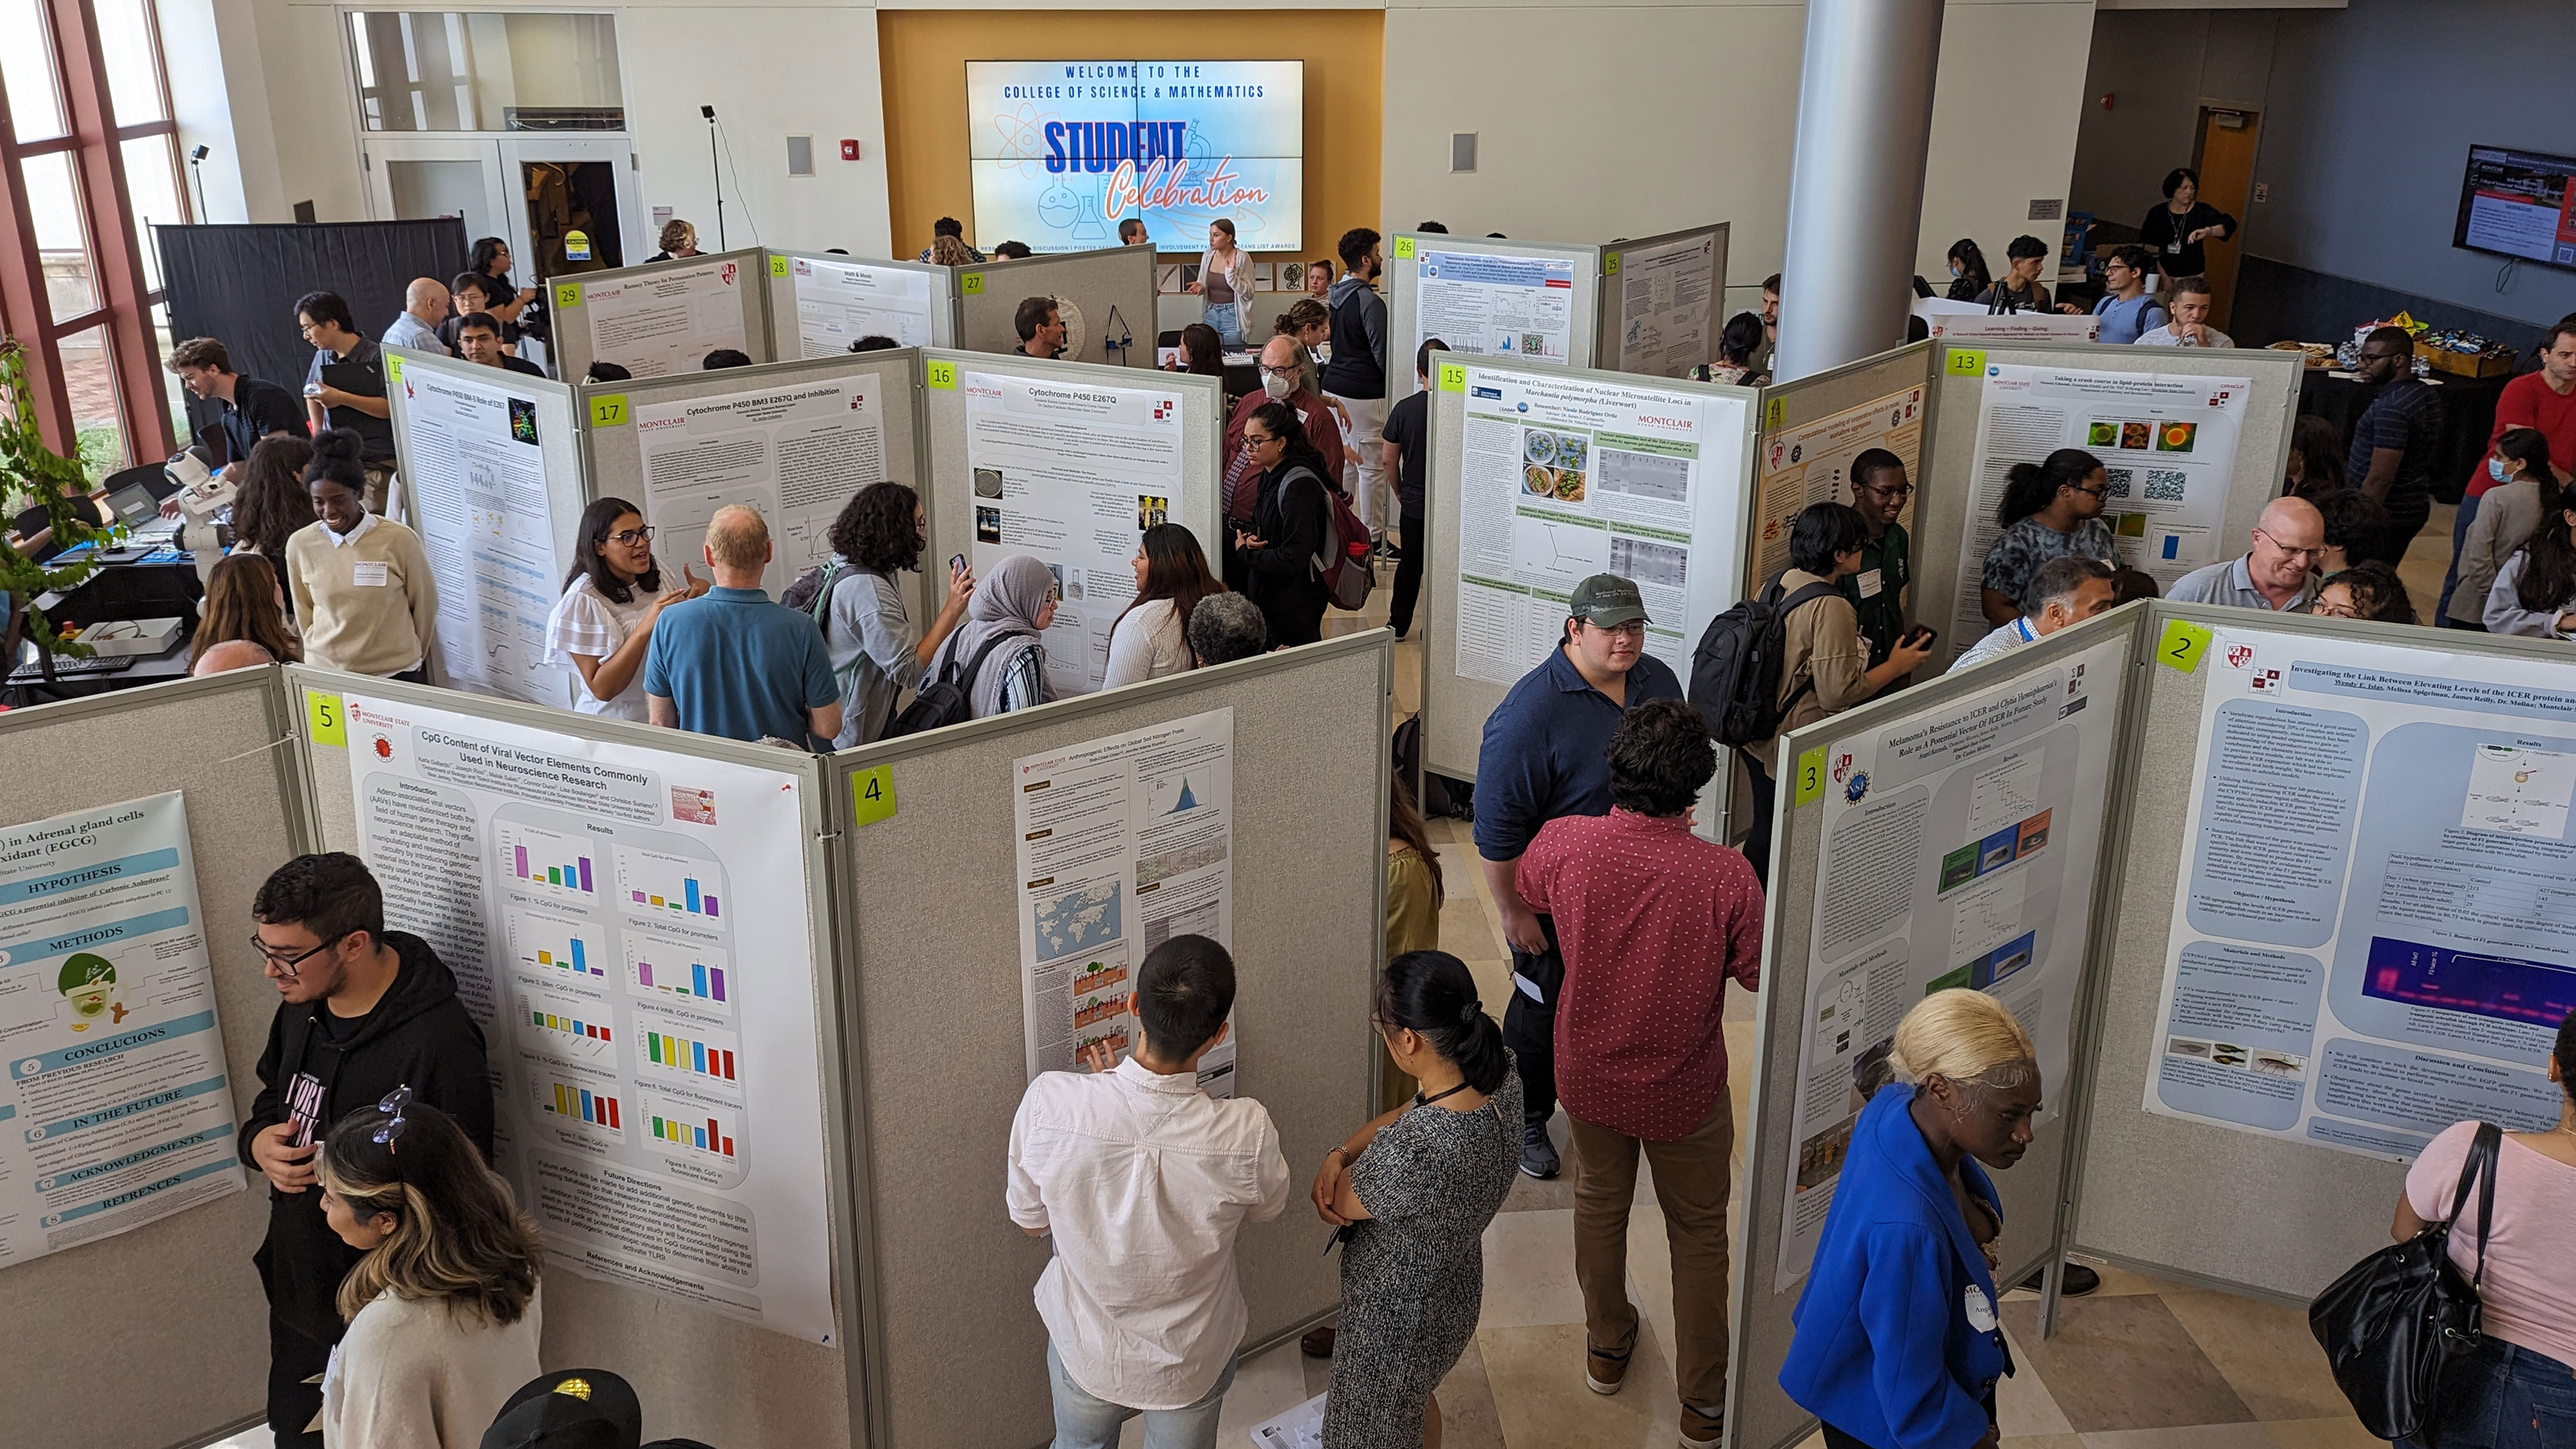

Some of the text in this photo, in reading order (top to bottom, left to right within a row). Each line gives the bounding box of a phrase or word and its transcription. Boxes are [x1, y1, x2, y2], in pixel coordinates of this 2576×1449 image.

[1065, 65, 1199, 79] WELCOME TO THE
[1004, 85, 1263, 99] COLLEGE OF SCIENCE & MATHEMATICS
[1045, 121, 1186, 173] STUDENT
[1108, 155, 1268, 218] Celebration
[1401, 242, 1411, 251] 26
[774, 263, 784, 272] 28
[1609, 259, 1616, 270] 25
[968, 278, 979, 288] 27
[563, 290, 575, 301] 29
[1956, 356, 1974, 369] 13
[935, 369, 949, 382] 16
[1447, 370, 1462, 383] 15
[966, 386, 1001, 396] MONTCLAIR
[1028, 387, 1117, 404] Cytochrome P450 E267Q
[1478, 372, 1517, 384] Identification
[1532, 379, 1584, 393] Characterization
[1593, 387, 1620, 397] Nuclear
[1620, 390, 1666, 403] Microsatellite
[1667, 396, 1682, 405] Loci
[687, 388, 840, 416] Cytochrome P450 BM3 E267Q and Inhibition
[1524, 388, 1637, 410] Marchantia polymorpha (Liverwort)
[600, 406, 618, 420] 17
[638, 417, 685, 429] MONTCLAIR
[1637, 415, 1692, 428] MONTCLAIR
[2171, 638, 2190, 658] 2
[2290, 664, 2341, 679] Investigating
[2357, 673, 2376, 681] Link
[2378, 675, 2412, 686] Between
[2414, 679, 2452, 691] Elevating
[2454, 684, 2479, 693] Levels
[2507, 690, 2530, 699] ICER
[2334, 679, 2359, 688] Wendy
[2386, 685, 2411, 693] Melissa
[2413, 688, 2450, 699] Spigelman,
[2474, 696, 2496, 704] Reilly,
[2509, 699, 2537, 708] Molina;
[2538, 703, 2573, 712] Montclair
[321, 705, 332, 727] 5
[361, 711, 410, 727] MONTCLAIR STATE
[2275, 708, 2311, 717] Introduction
[362, 717, 393, 729] UNIVERSITY
[1888, 729, 1928, 749] Melanoma's
[1929, 717, 1962, 735] Resistance
[1970, 706, 1988, 720] ICER
[1988, 701, 1999, 712] and
[1898, 696, 2047, 758] Role as A Potential Vector Of ICER In Future Study
[1127, 737, 1142, 746] Global
[1152, 731, 1171, 740] Nitrogen
[2516, 739, 2541, 747] Results
[421, 731, 648, 785] CpG Content of Viral Vector Elements Commonly
[459, 752, 607, 791] Used in Neuroscience Research
[1806, 767, 1815, 791] 3
[398, 781, 437, 796] Introduction
[865, 778, 881, 801] 4
[8, 810, 144, 847] in Adrenal gland cells
[586, 823, 613, 835] Results
[45, 834, 97, 856] (EGCG)
[19, 861, 56, 872] University
[27, 864, 121, 894] HYPOTHESIS
[48, 926, 123, 952] METHODS
[64, 1027, 165, 1061] CONCLUCIONS
[16, 1053, 123, 1086] FROM PREVIOUS RESEARCH
[27, 1063, 35, 1071] 5
[2414, 1055, 2450, 1066] Discussion
[2467, 1064, 2508, 1076] Conclusions
[73, 1090, 183, 1128] IN THE FUTURE
[34, 1130, 42, 1139] 6
[69, 1133, 204, 1182] ACKNOWLEDGMENTS
[44, 1180, 52, 1188] 7
[604, 1170, 662, 1191] Future Directions
[102, 1174, 180, 1208] REFRENCES
[586, 1251, 704, 1290] References and Acknowledgements
